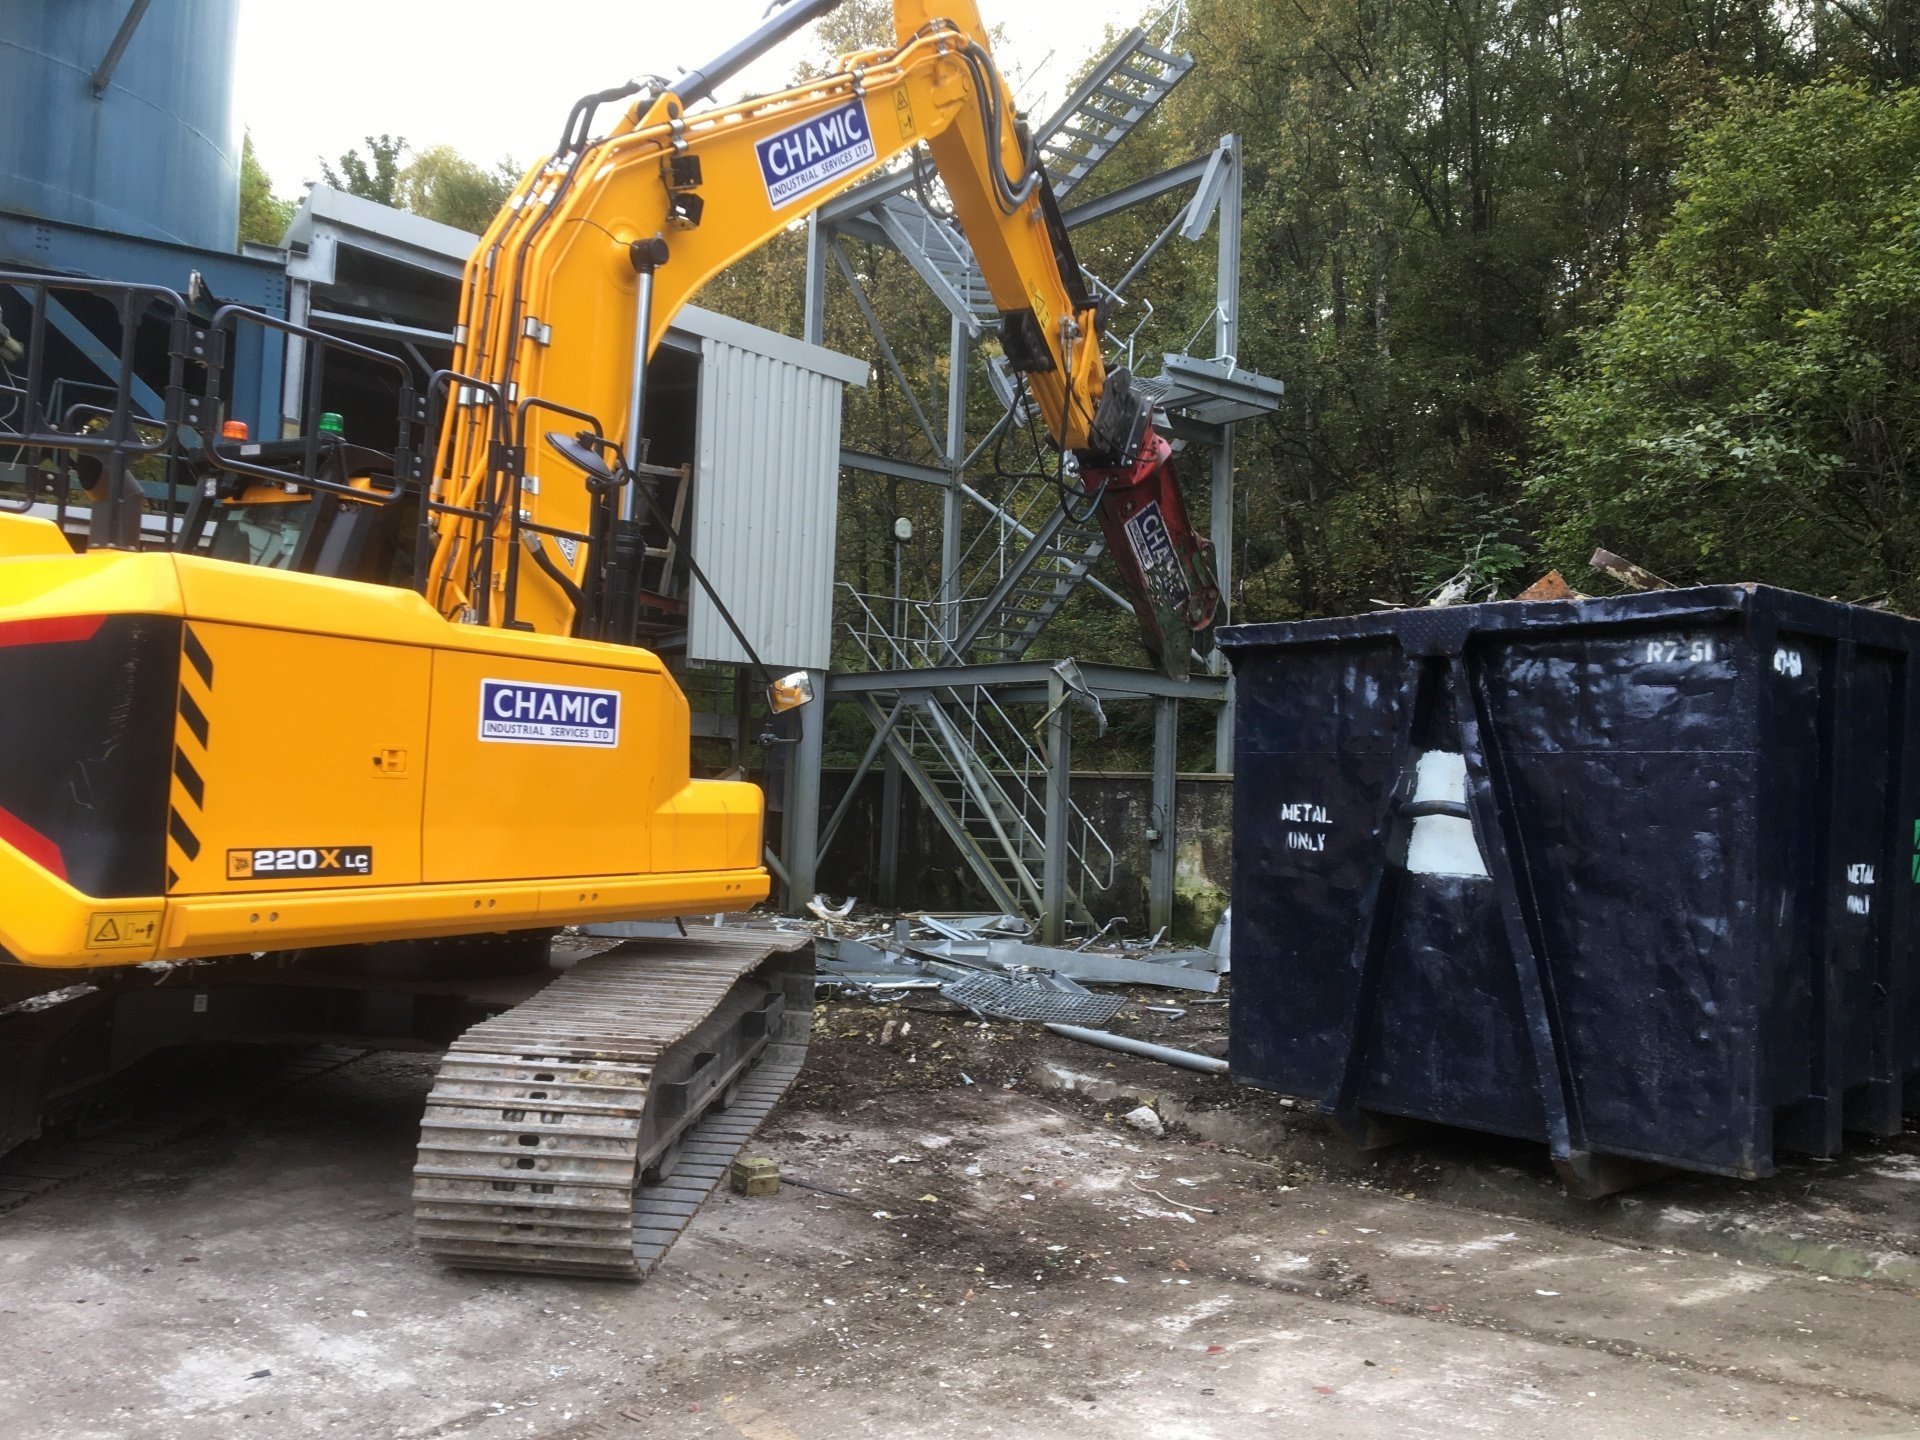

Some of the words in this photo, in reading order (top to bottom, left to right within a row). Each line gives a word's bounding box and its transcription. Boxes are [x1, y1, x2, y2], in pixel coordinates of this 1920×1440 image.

[767, 108, 862, 176] CHAMIC
[772, 168, 819, 198] INDUSTRIAL
[821, 150, 853, 175] SERVICES
[854, 143, 868, 158] LTD
[1142, 514, 1184, 598] CHA
[493, 688, 608, 725] CHAMIC
[486, 723, 545, 736] INDUSTRIAL
[550, 726, 589, 738] SERVICES
[593, 729, 609, 739] LTD
[1281, 803, 1333, 823] METAL
[345, 854, 368, 868] LC
[1847, 863, 1875, 884] METAL
